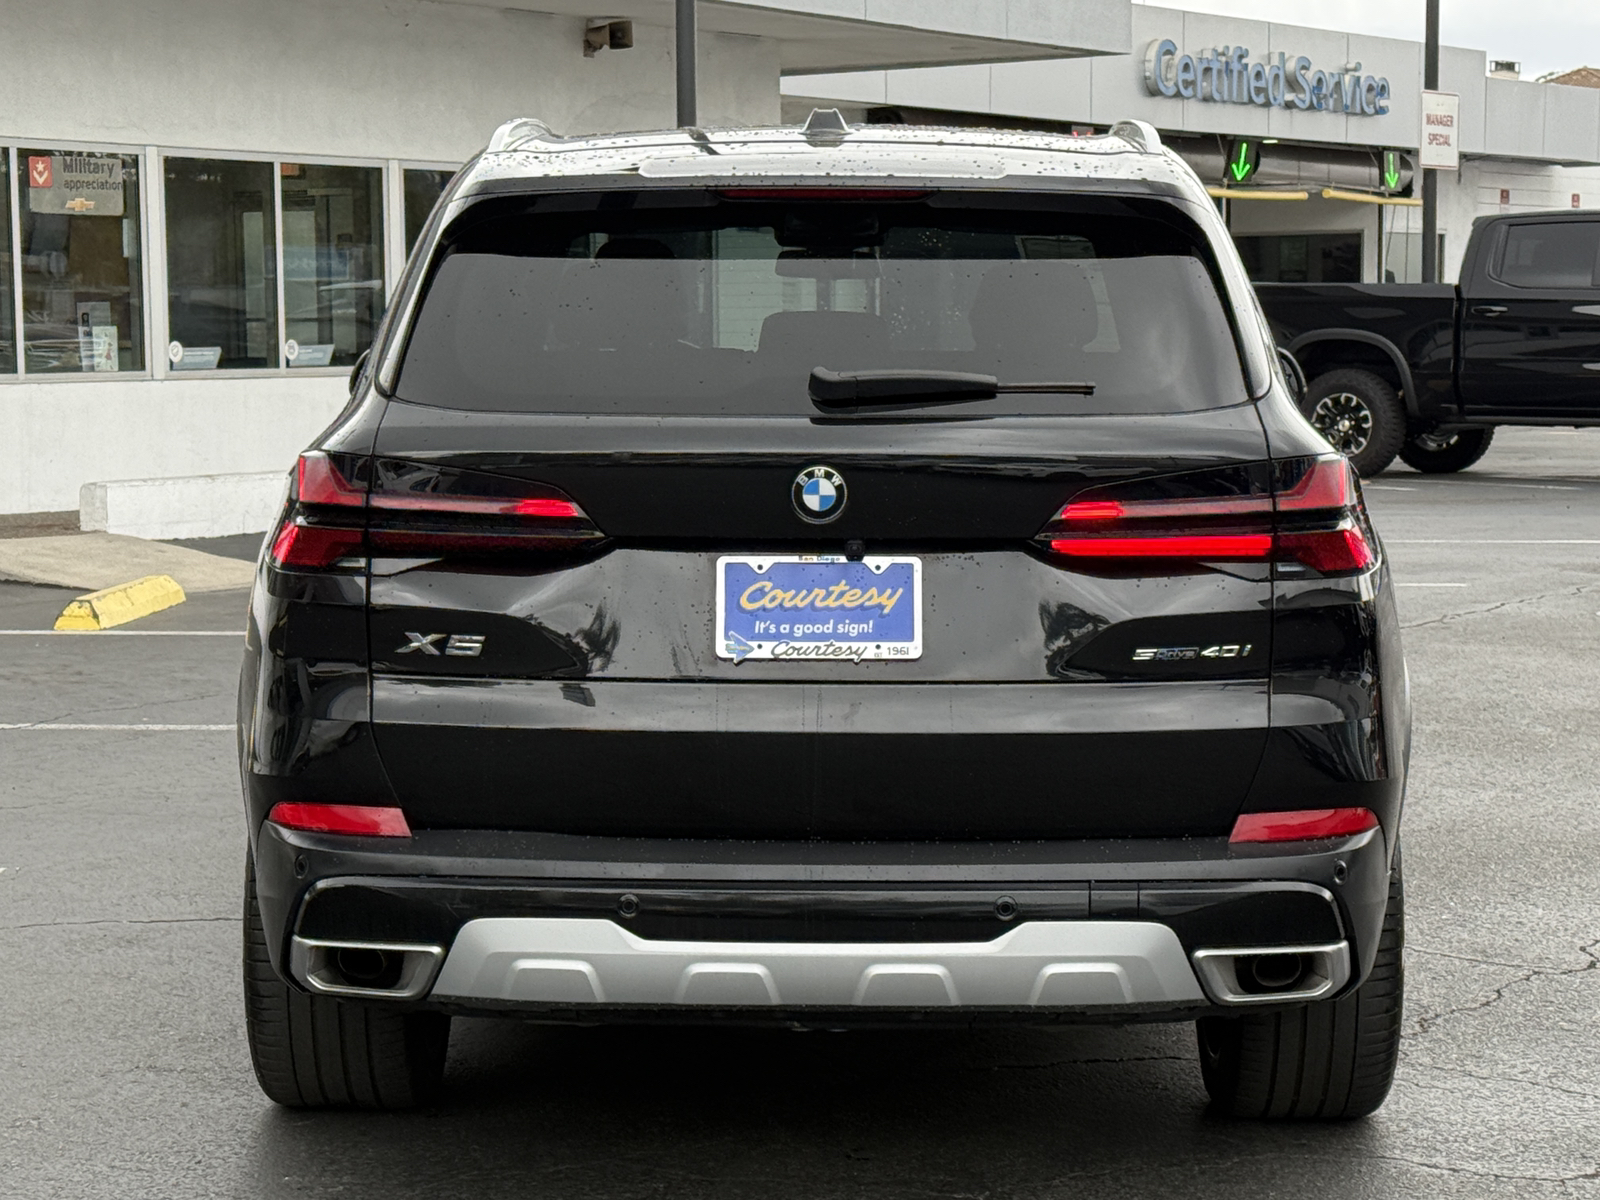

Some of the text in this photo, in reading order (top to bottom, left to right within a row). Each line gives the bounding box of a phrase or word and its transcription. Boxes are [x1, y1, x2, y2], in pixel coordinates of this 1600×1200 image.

[1146, 38, 1390, 115] Certified Service
[1425, 113, 1454, 127] MANAGER
[1427, 132, 1452, 147] SPECIAL
[63, 156, 114, 178] Military
[63, 177, 123, 192] appreciation
[797, 469, 842, 487] BMW
[739, 580, 903, 615] Courtesy
[754, 619, 874, 637] It's a good sign!
[394, 631, 486, 656] X5
[770, 641, 910, 662] Courtesy 1961
